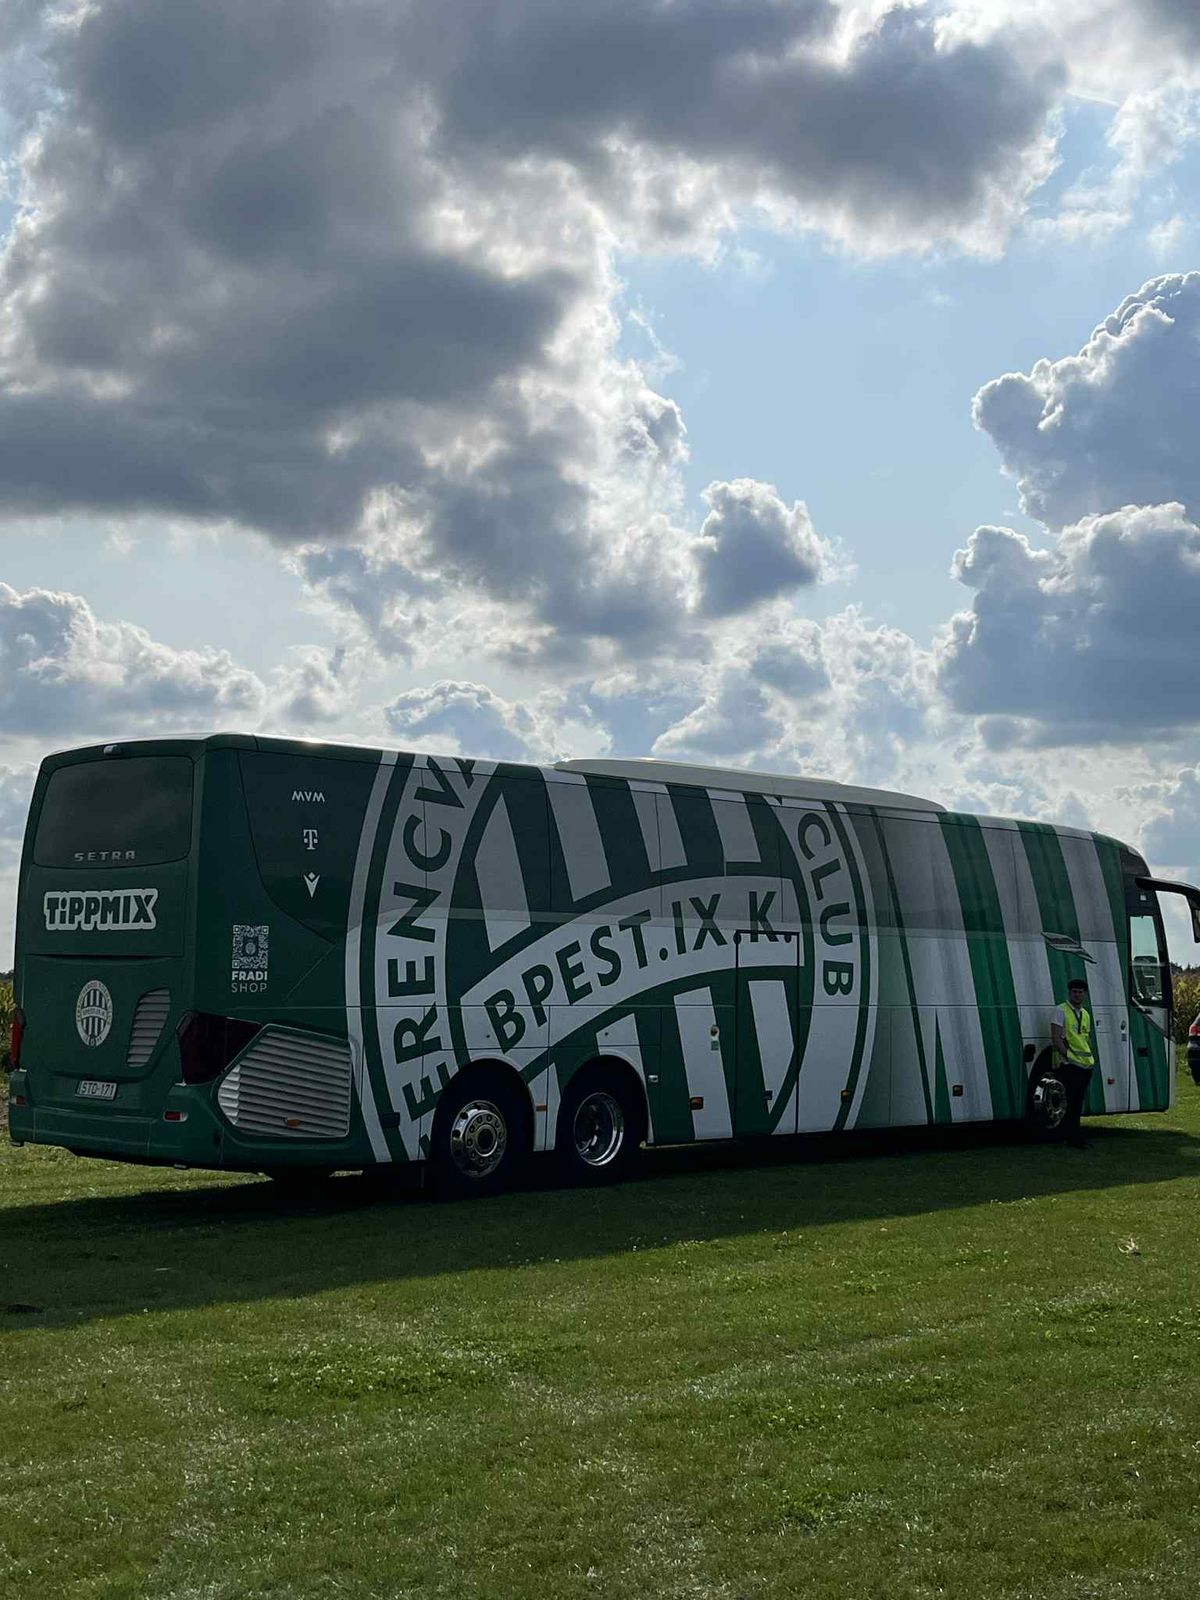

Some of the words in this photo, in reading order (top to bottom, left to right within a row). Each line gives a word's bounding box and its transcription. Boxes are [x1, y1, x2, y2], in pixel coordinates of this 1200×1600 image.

[291, 790, 326, 803] MVM
[74, 850, 136, 862] SETRA
[798, 812, 854, 996] CLUB
[387, 754, 476, 1161] ERENCV
[231, 970, 268, 981] FRADI
[231, 982, 268, 993] SHOP
